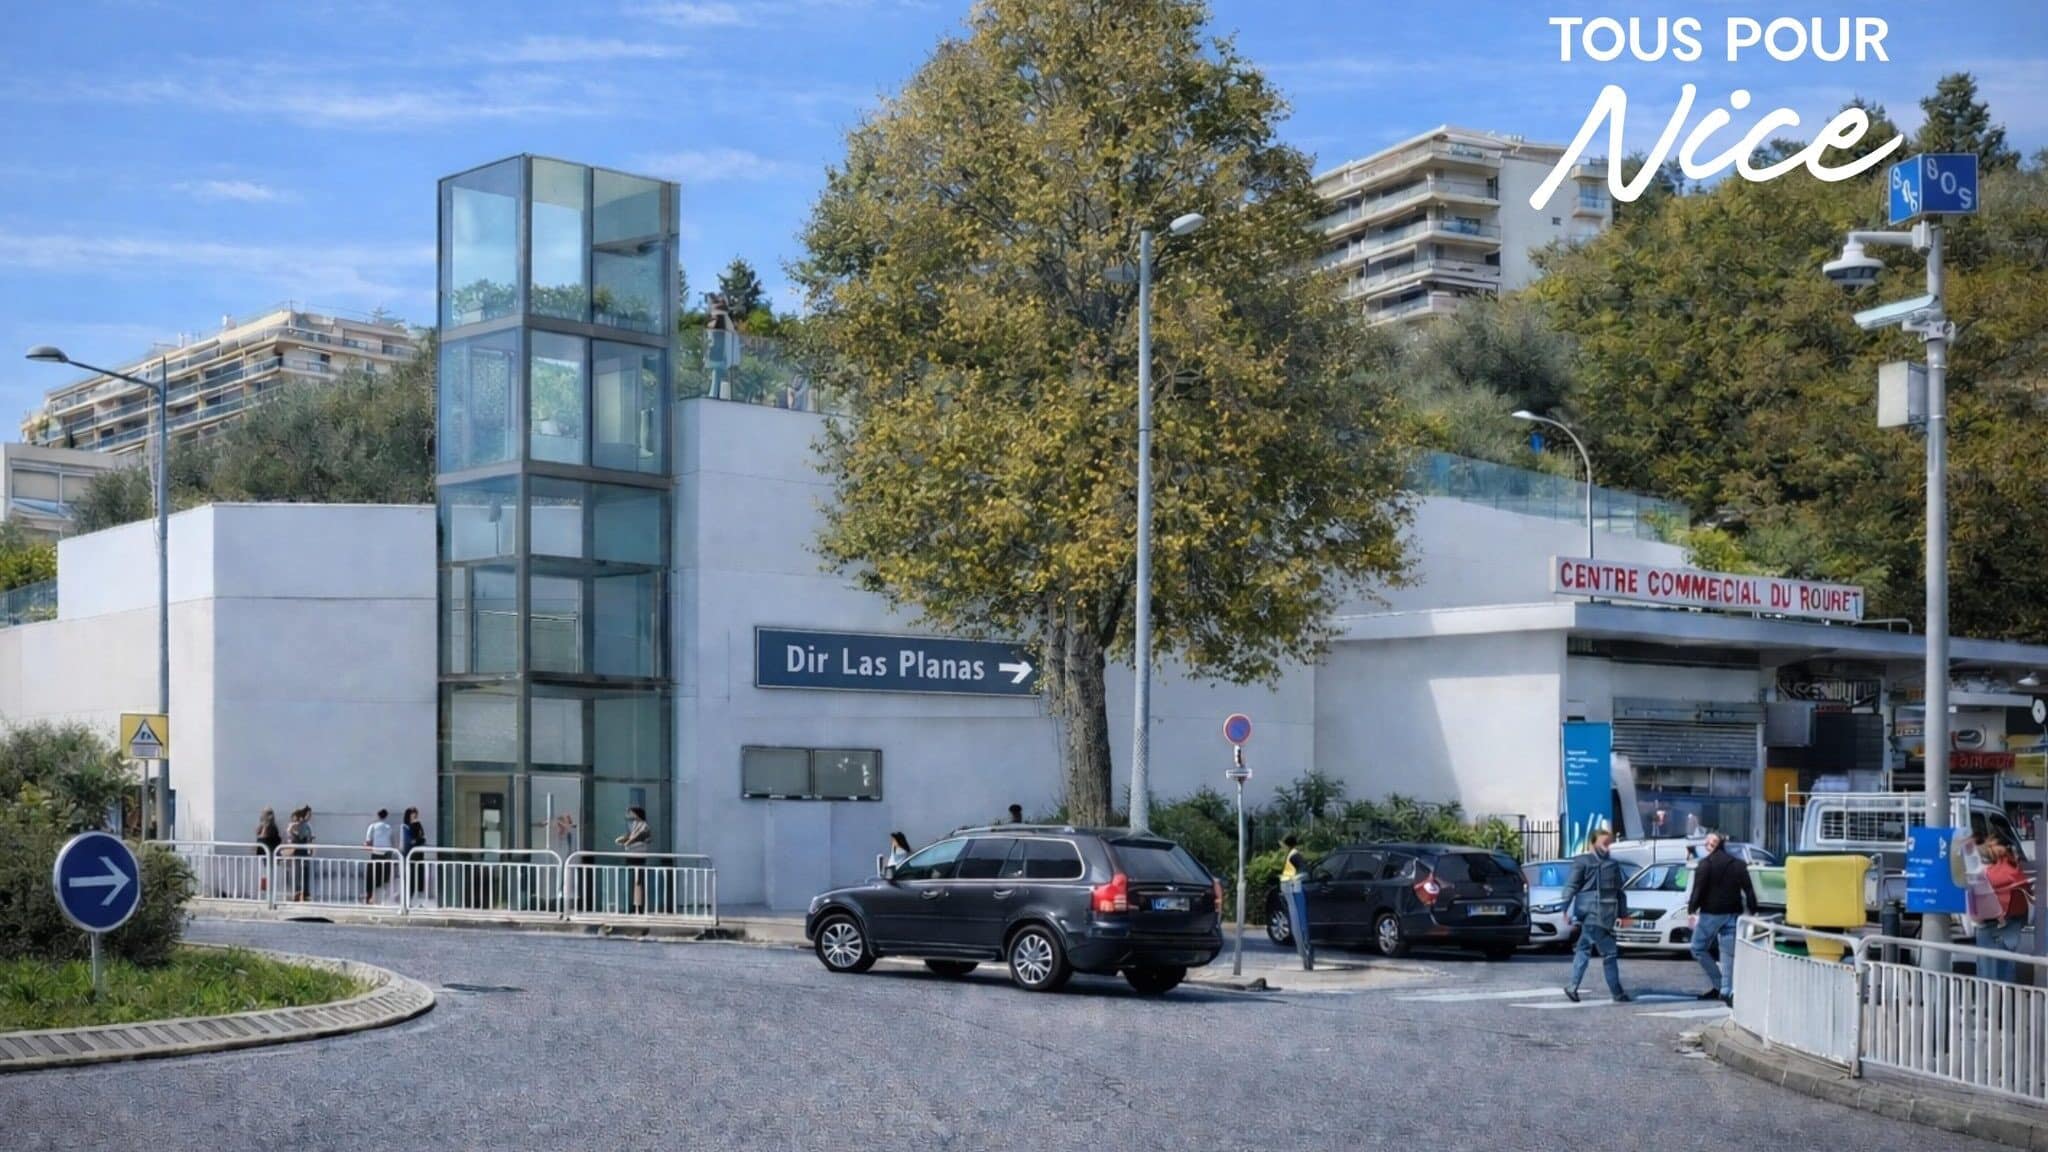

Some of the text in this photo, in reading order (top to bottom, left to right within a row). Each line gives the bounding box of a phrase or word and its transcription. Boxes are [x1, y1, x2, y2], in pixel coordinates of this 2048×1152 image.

[1560, 561, 1638, 593] CENTRE
[1770, 583, 1791, 608] DU
[1800, 585, 1860, 619] ROURET
[786, 644, 985, 681] Dir Las Planas
